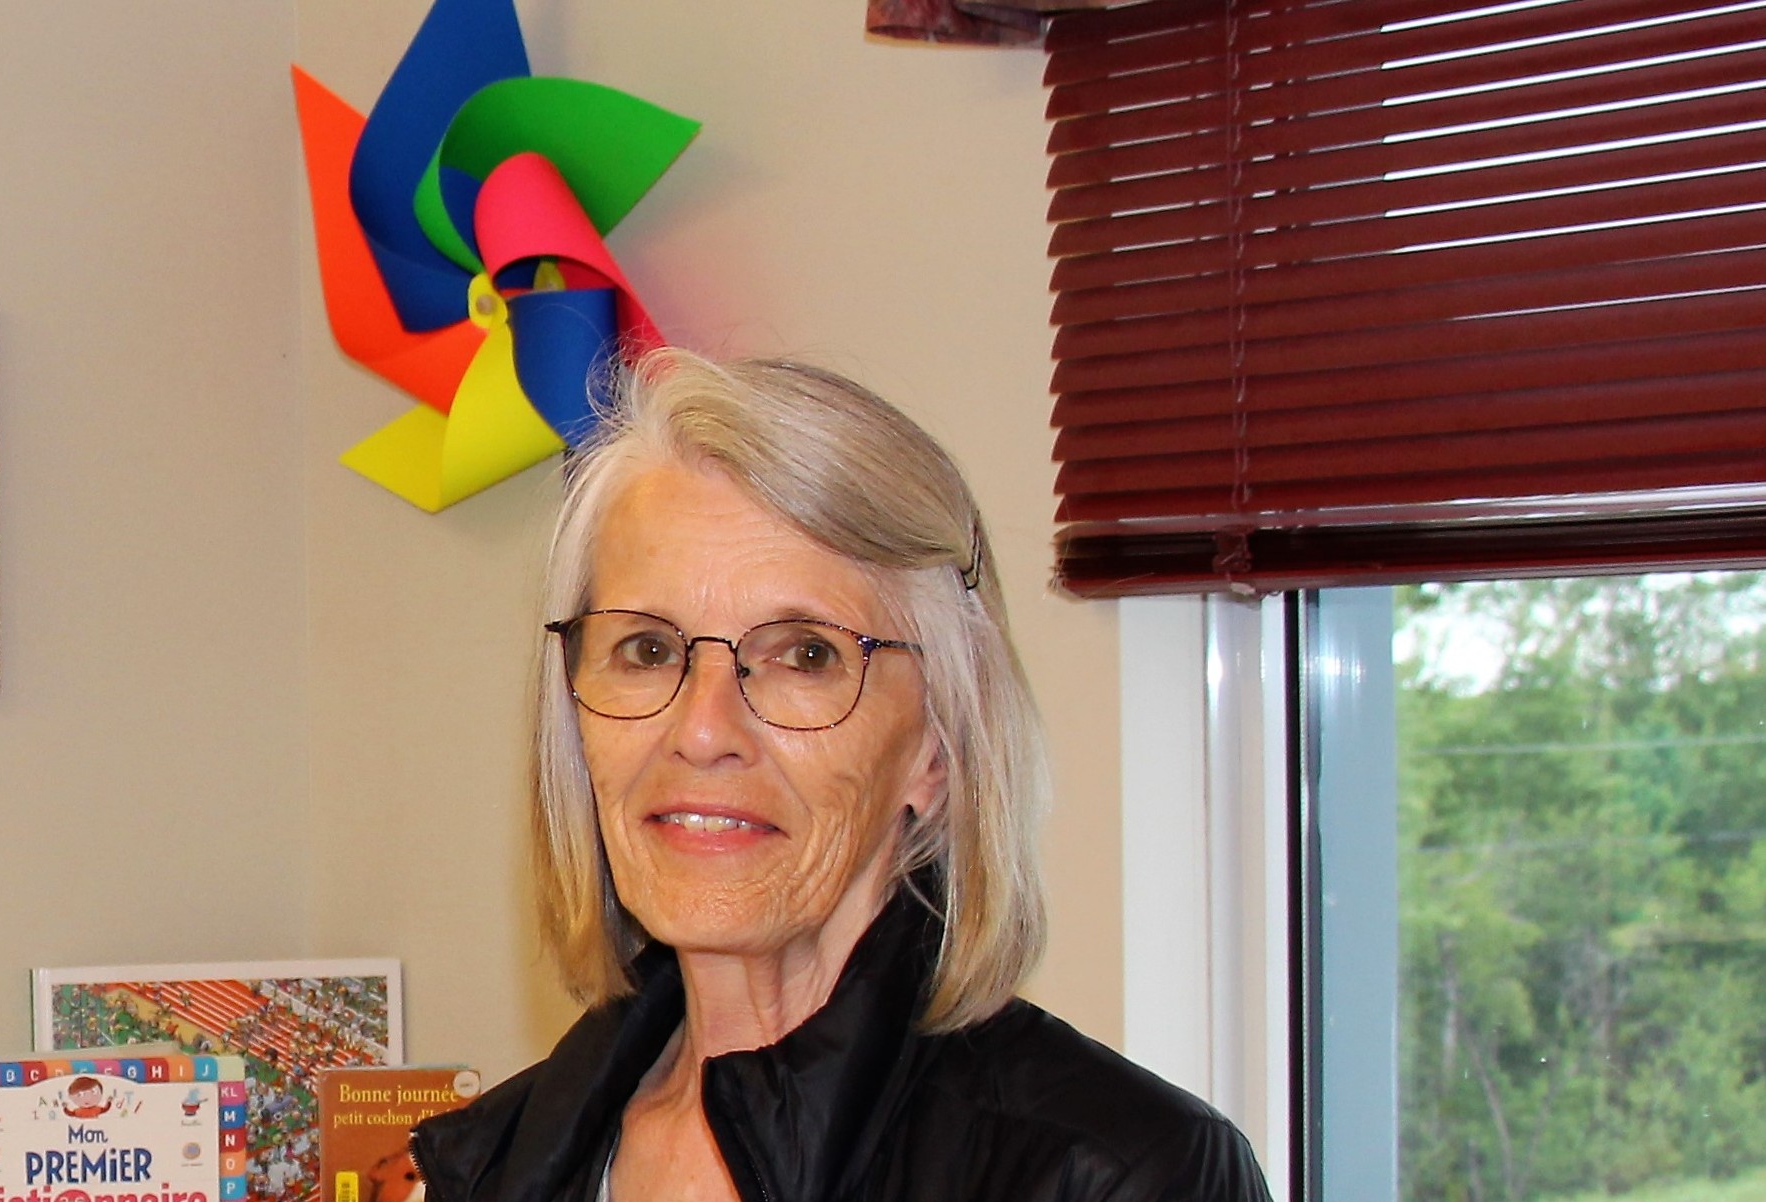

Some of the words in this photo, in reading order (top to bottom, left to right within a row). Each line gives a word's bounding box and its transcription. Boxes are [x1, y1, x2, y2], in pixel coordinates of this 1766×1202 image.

[6, 1069, 16, 1082] B
[30, 1068, 39, 1081] C
[152, 1066, 163, 1078] H
[202, 1064, 210, 1077] J
[221, 1087, 238, 1098] KL
[339, 1083, 391, 1103] Bonne
[396, 1083, 458, 1106] journée
[224, 1110, 236, 1123] M
[334, 1109, 362, 1128] petit
[367, 1109, 413, 1125] cochon
[67, 1124, 108, 1144] Mon
[225, 1134, 236, 1147] N
[226, 1182, 236, 1194] P
